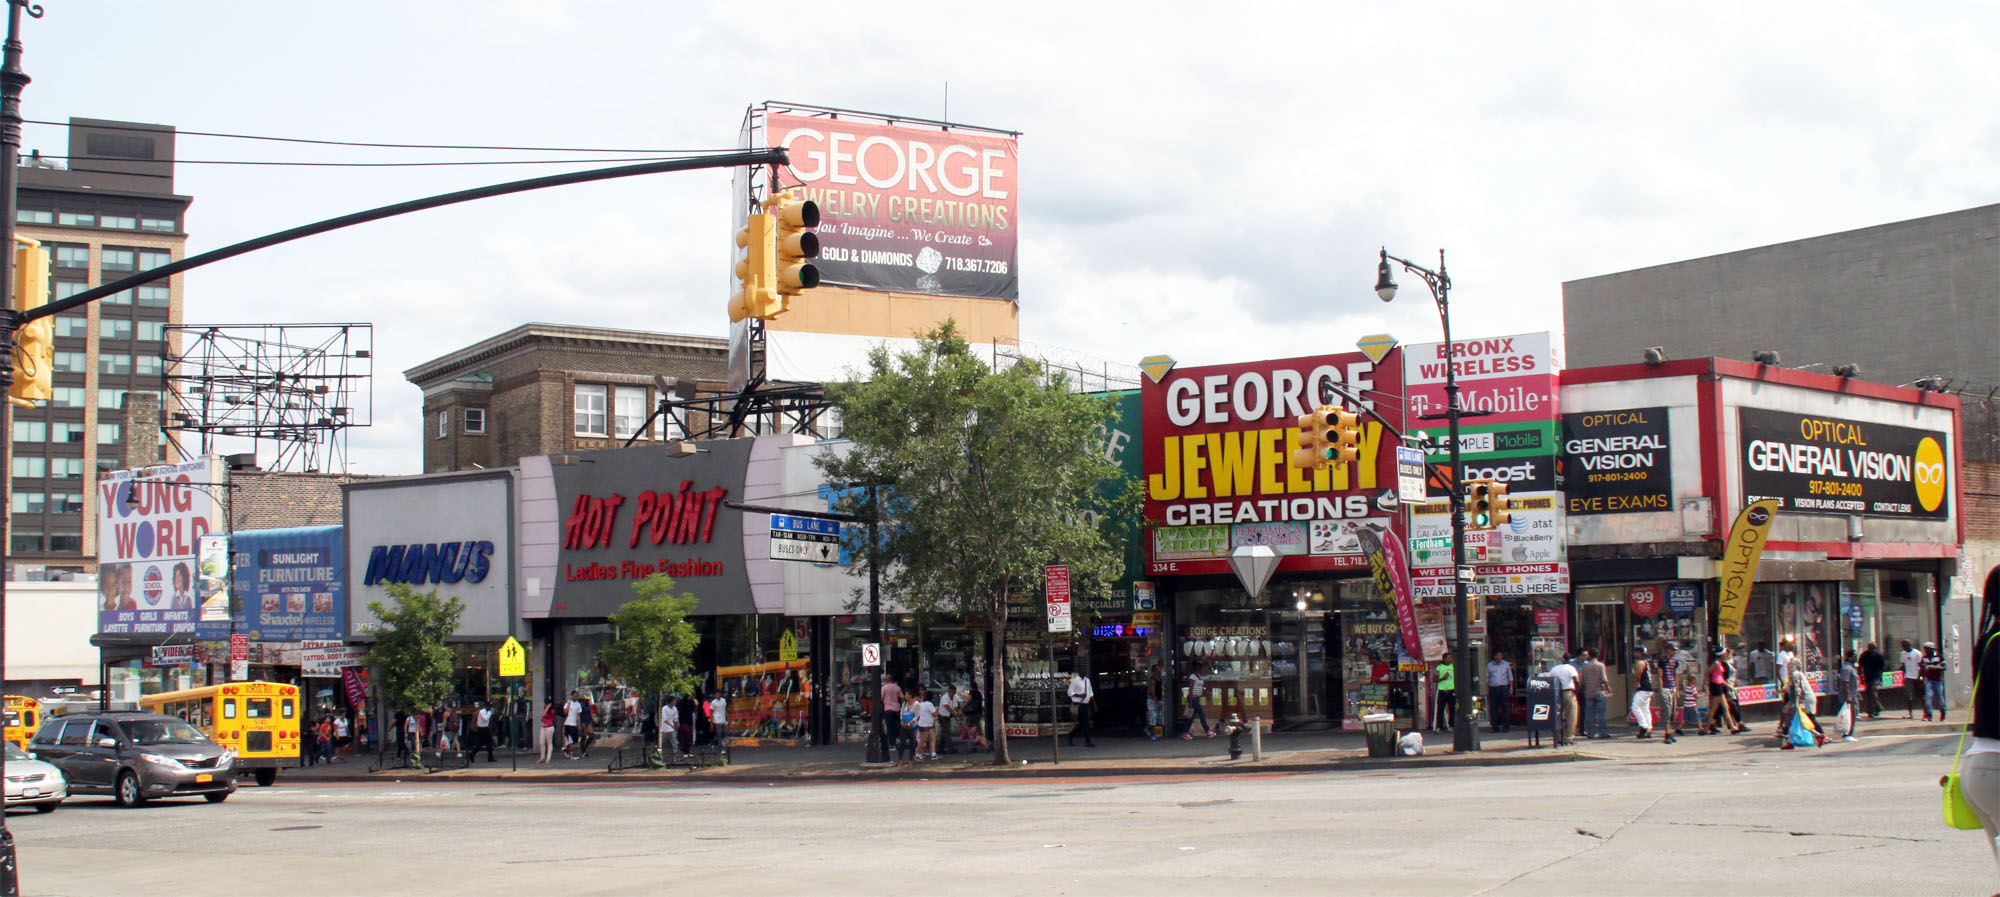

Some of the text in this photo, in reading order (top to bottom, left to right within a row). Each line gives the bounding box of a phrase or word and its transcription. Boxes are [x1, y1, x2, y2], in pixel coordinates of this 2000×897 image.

[780, 128, 1008, 199] GEORGE
[792, 187, 1008, 231] EWELRY CREATIONS
[841, 223, 895, 240] Imagine
[911, 229, 932, 242] We
[935, 231, 972, 245] Create
[822, 247, 1008, 274] GOLD & DIAMONDS 718.367.7206
[1437, 338, 1514, 359] BRONX
[1420, 355, 1535, 379] WIRELESS
[1167, 362, 1375, 426] GEORGE
[1583, 413, 1648, 427] OPTICAL
[1801, 418, 1867, 445] OPTICAL
[1496, 433, 1539, 448] Mobile
[1566, 435, 1667, 454] GENERAL
[1580, 453, 1653, 470] VISION
[1749, 440, 1911, 482] GENERAL VISION
[1464, 461, 1536, 481] boost
[1588, 472, 1647, 482] 917-801-2400
[102, 474, 192, 518] YOUNG
[1809, 480, 1862, 496] 917-801-2400
[1167, 495, 1368, 526] CREATIONS
[1570, 494, 1668, 511] EYE EXAMS
[1795, 498, 1815, 508] VISION
[1816, 499, 1835, 509] PLANS
[1835, 500, 1865, 511] ACCEPTED
[1874, 502, 1911, 512] CONTACT LENS
[564, 493, 626, 551] HOT
[793, 520, 820, 530] BUS LANE
[1532, 519, 1553, 528] at&t
[115, 516, 209, 559] WORLD
[1235, 525, 1289, 537] PERFUMES
[1417, 537, 1444, 549] Fordham
[272, 553, 319, 564] SUNLIGHT
[1530, 549, 1551, 559] Apple
[363, 540, 494, 586] MANUS
[566, 558, 723, 581] Ladies Fine Fashion
[1153, 563, 1168, 572] 334
[1506, 565, 1551, 573] PHONES
[1719, 528, 1758, 613] OPTICAL
[260, 567, 334, 582] FURNITURE
[1415, 584, 1557, 595] PAY ALL OUR BILLS HERE
[119, 611, 189, 621] BOYS GIRLS INFANTS
[104, 624, 129, 633] LAYETTE
[134, 623, 167, 632] FURNITURE
[173, 623, 195, 632] UNIFOR
[1189, 626, 1267, 635] EORGE CREATIONS
[1354, 625, 1366, 634] WE
[1368, 625, 1382, 633] BUY
